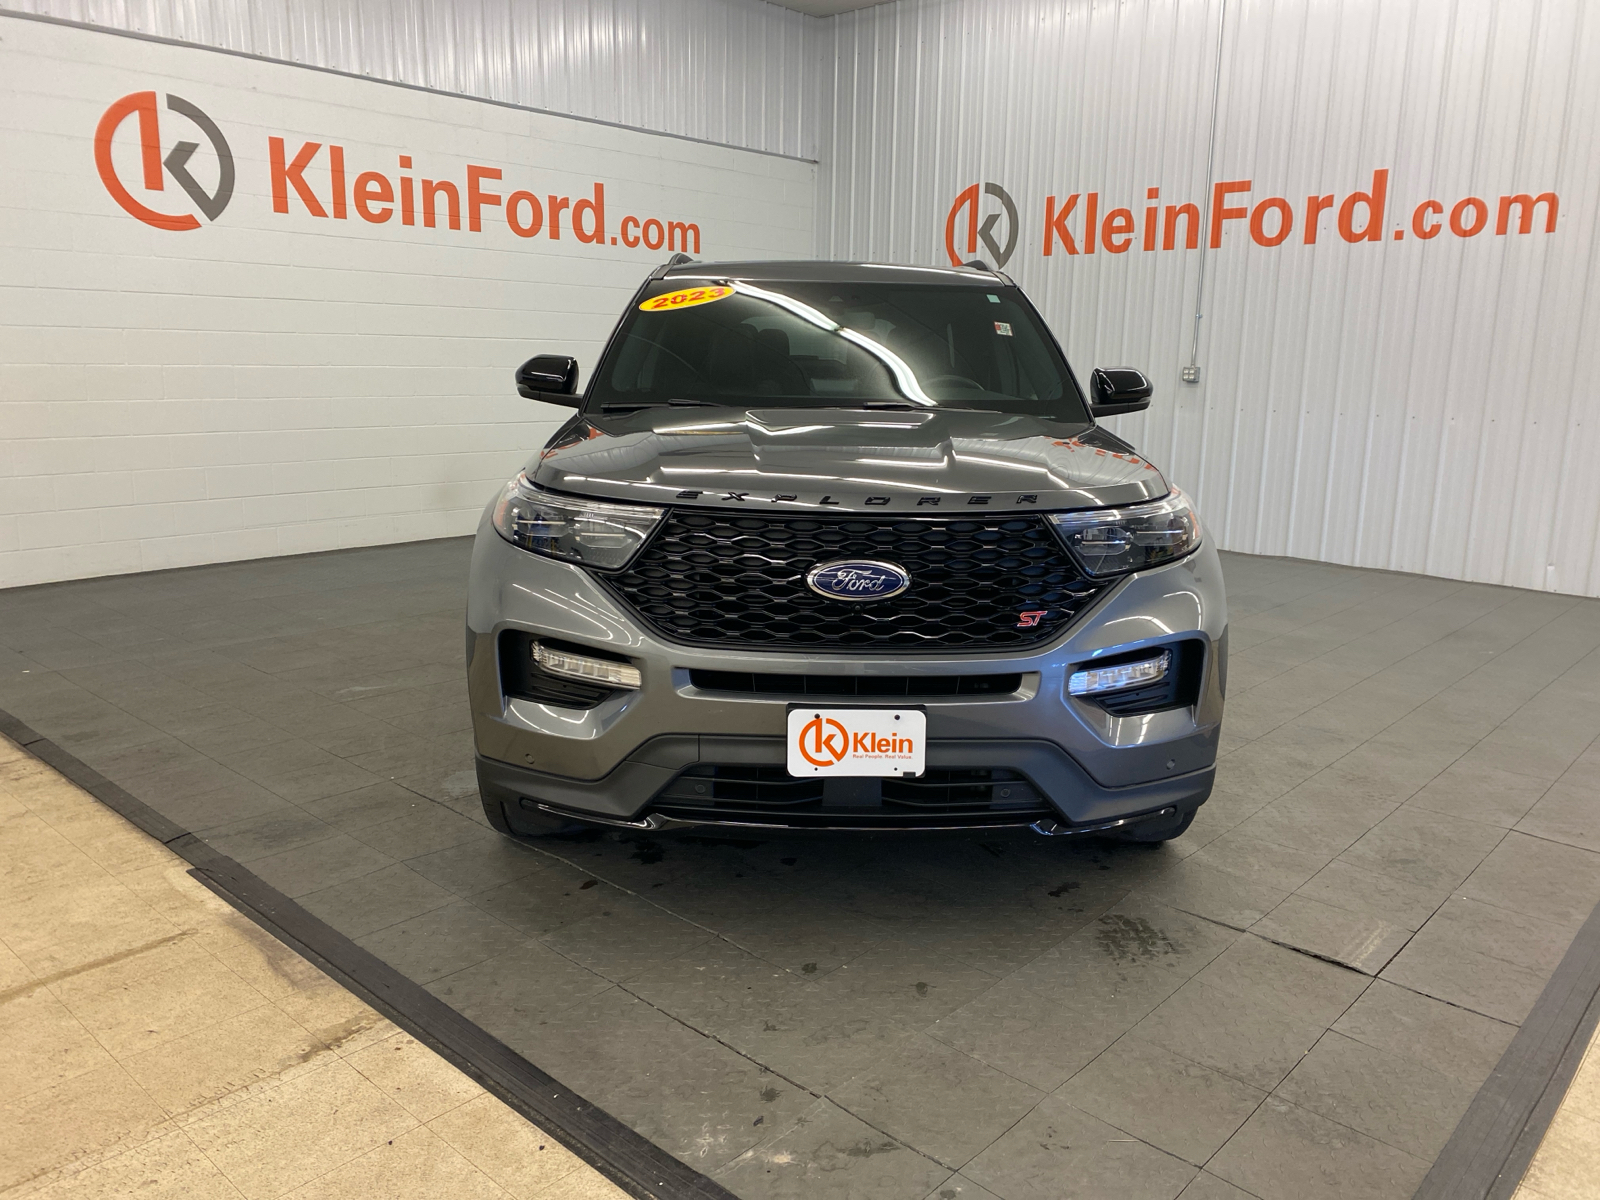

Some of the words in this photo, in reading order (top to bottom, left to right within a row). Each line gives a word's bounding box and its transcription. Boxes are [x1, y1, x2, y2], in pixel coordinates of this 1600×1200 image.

[268, 136, 701, 254] KleinFord.com
[1043, 169, 1559, 256] KleinFord.com
[651, 287, 726, 309] 2023
[676, 490, 1038, 506] EXPLORER
[832, 568, 885, 592] Ford
[1017, 611, 1047, 627] ST
[853, 732, 913, 753] Klein
